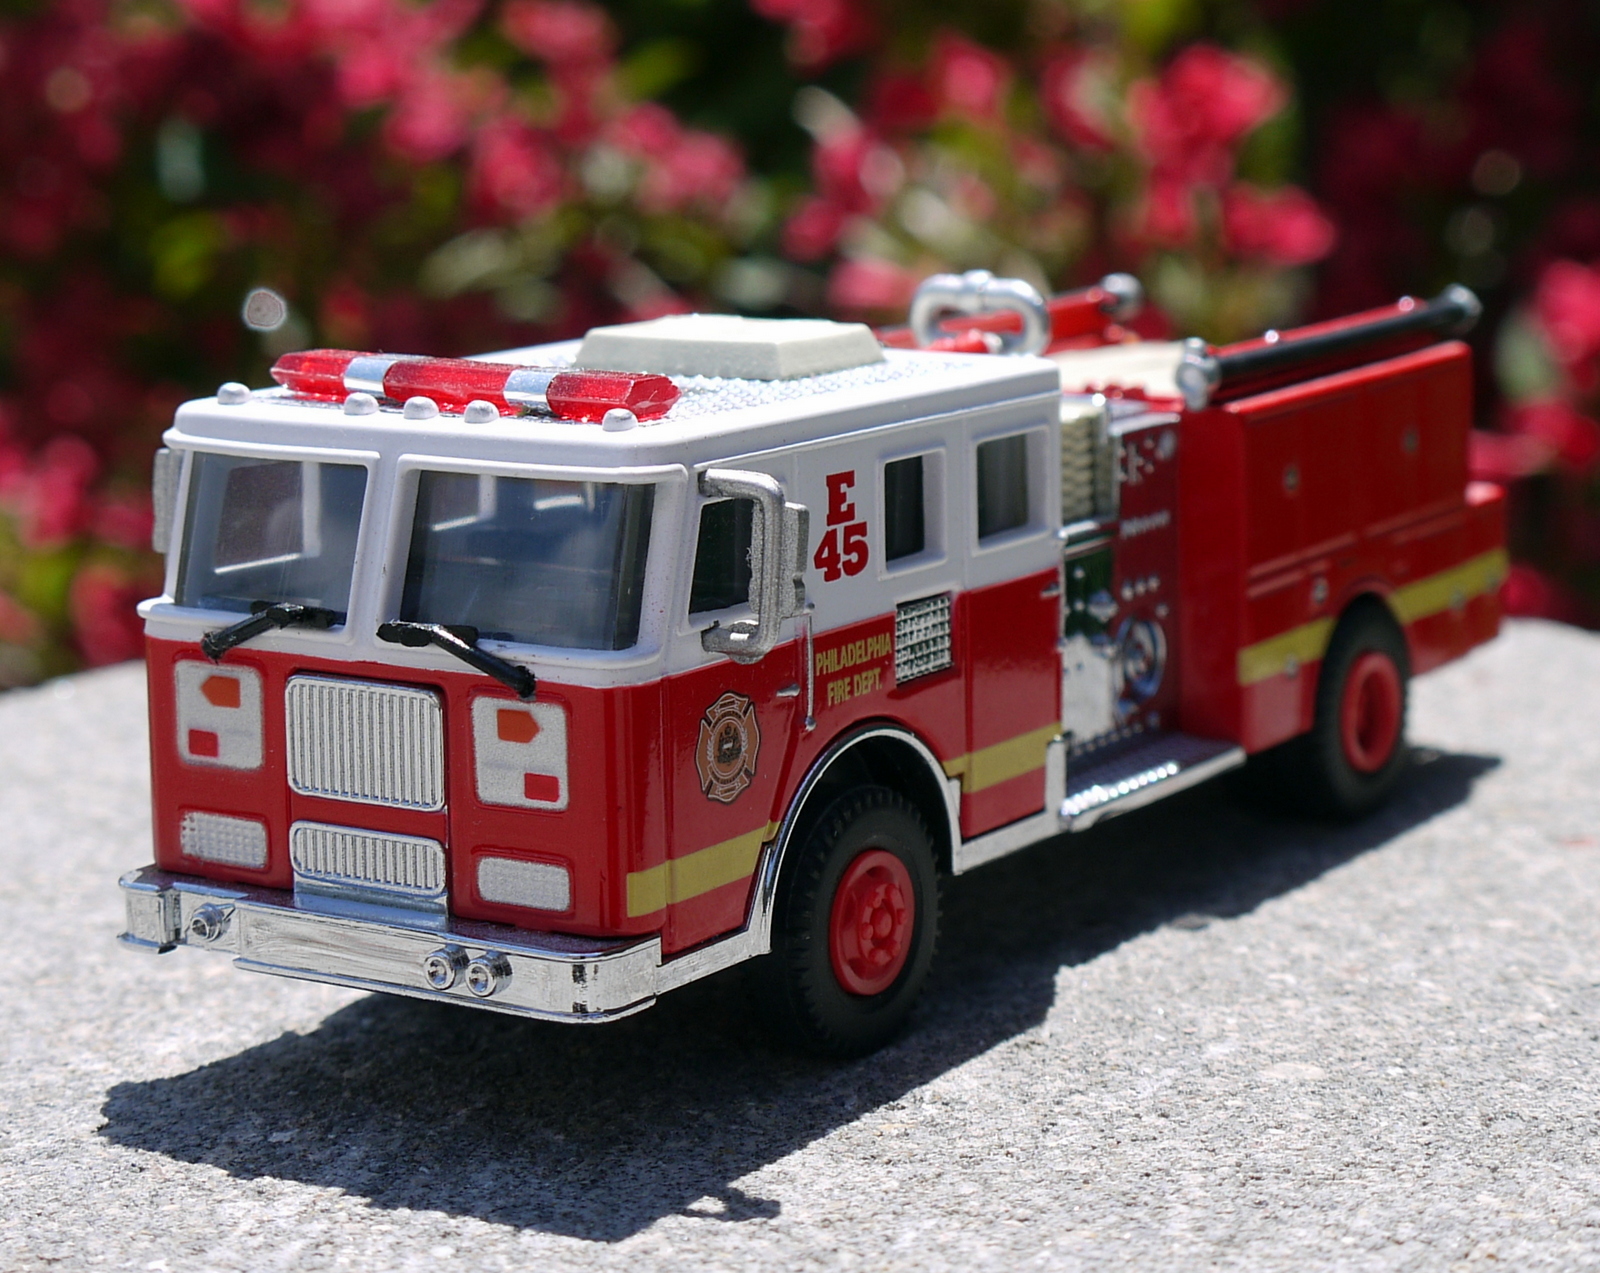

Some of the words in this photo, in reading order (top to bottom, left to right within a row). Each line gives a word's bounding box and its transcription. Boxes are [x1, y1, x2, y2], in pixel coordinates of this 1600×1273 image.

[826, 470, 855, 526] E
[813, 521, 869, 582] 45
[816, 632, 892, 677] PHILADELPHIA
[827, 676, 851, 706] FIRE
[854, 667, 883, 697] DEPT.
